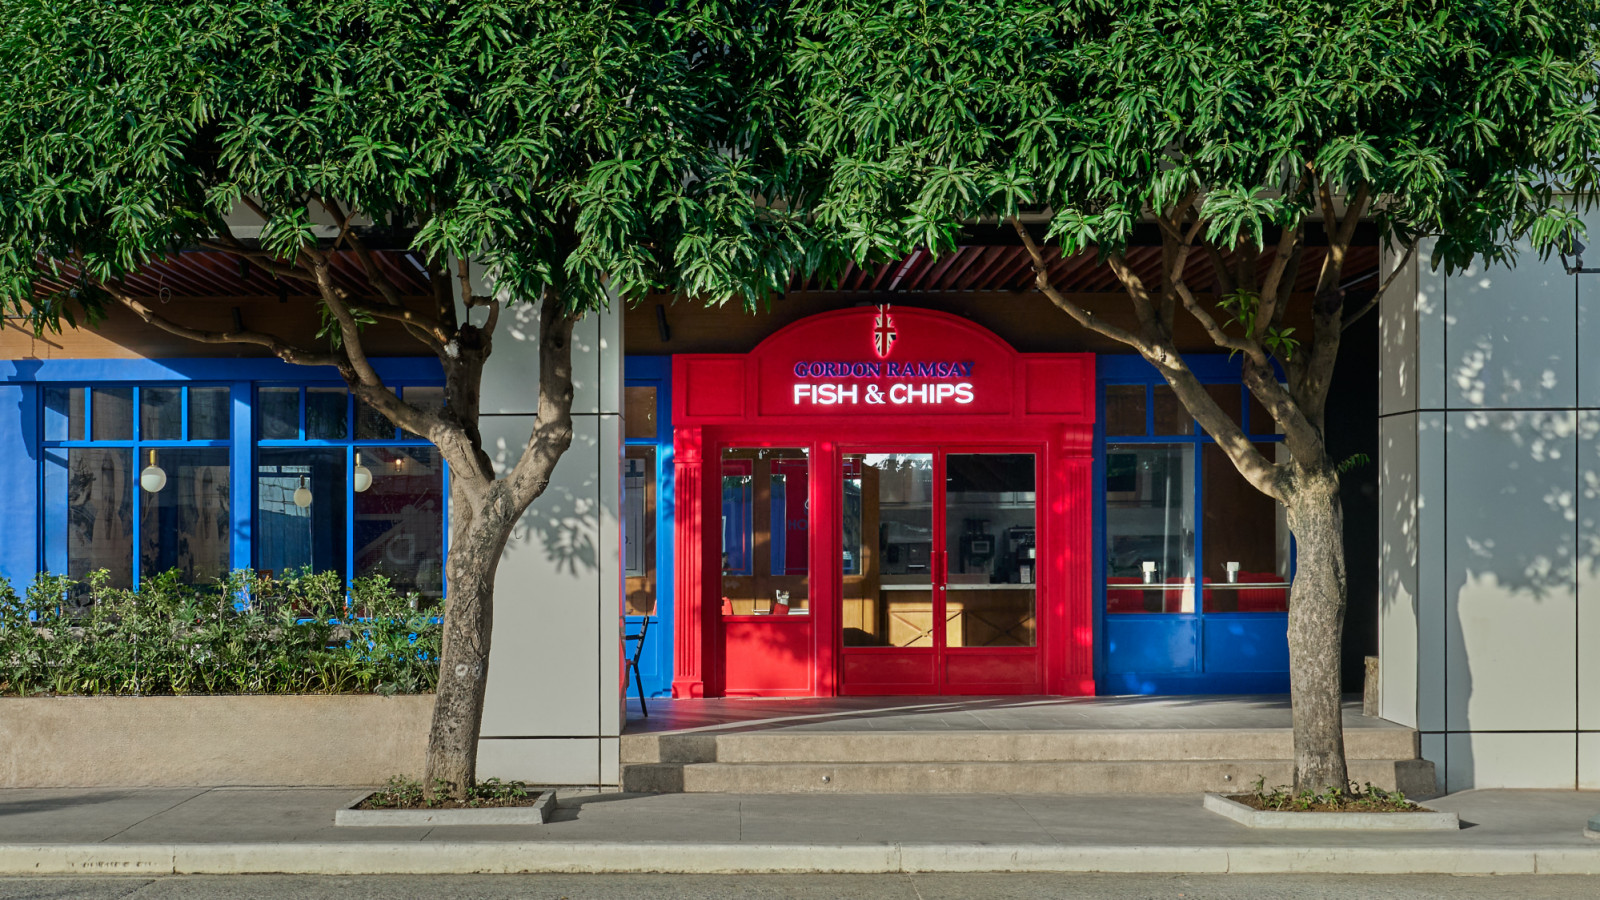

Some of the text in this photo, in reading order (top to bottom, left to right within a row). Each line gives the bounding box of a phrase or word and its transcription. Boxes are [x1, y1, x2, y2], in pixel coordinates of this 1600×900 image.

[794, 361, 974, 377] GORDON RAMSAY
[793, 382, 974, 405] FISH & CHIPS
